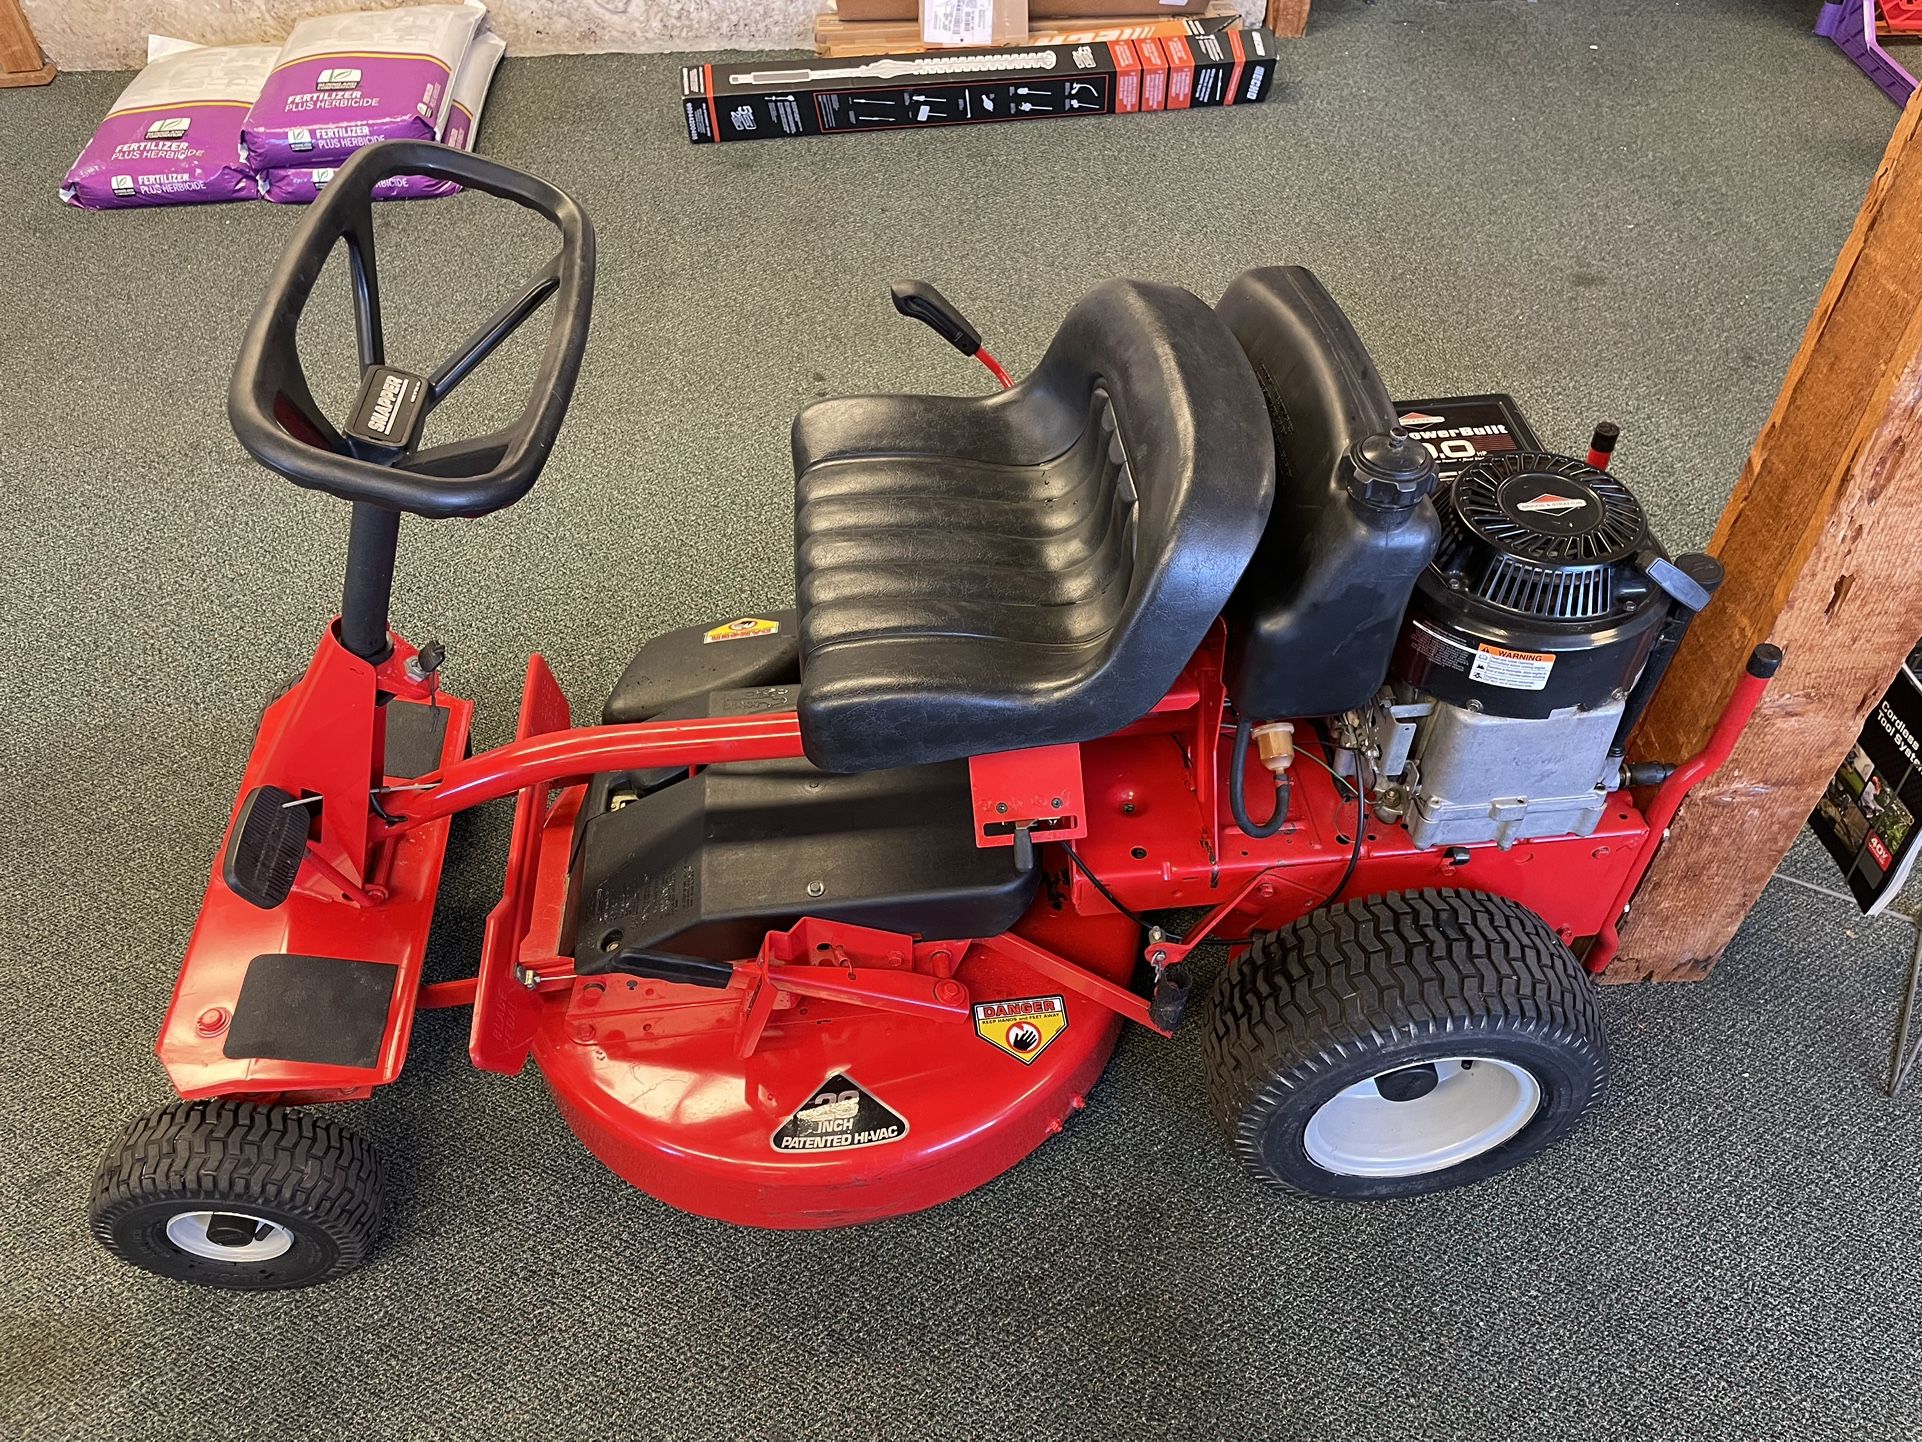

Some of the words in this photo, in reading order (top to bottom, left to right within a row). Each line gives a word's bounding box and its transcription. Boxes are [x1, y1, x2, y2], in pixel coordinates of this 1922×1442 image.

[287, 91, 362, 104] FERTILIZER
[285, 101, 314, 112] PLUS
[316, 98, 380, 109] HERBICIDE
[315, 125, 370, 139] FERTILIZER
[115, 141, 189, 153] FERTILIZER
[318, 138, 341, 149] PLUS
[111, 150, 140, 161] PLUS
[142, 149, 205, 160] HERBICIDE
[138, 173, 190, 185] FERTILIZER
[140, 184, 162, 195] PLUS
[162, 181, 207, 194] HERBICIDE
[367, 375, 403, 433] SNAPPER
[1408, 424, 1509, 440] owerBuilt
[1497, 649, 1542, 662] WARNING
[1877, 709, 1895, 737] Tool
[1881, 700, 1920, 751] Cordless
[983, 1000, 1056, 1019] DANGER
[815, 1118, 854, 1134] INCH
[781, 1133, 852, 1149] PATENTED
[853, 1125, 898, 1145] HI-VAC
